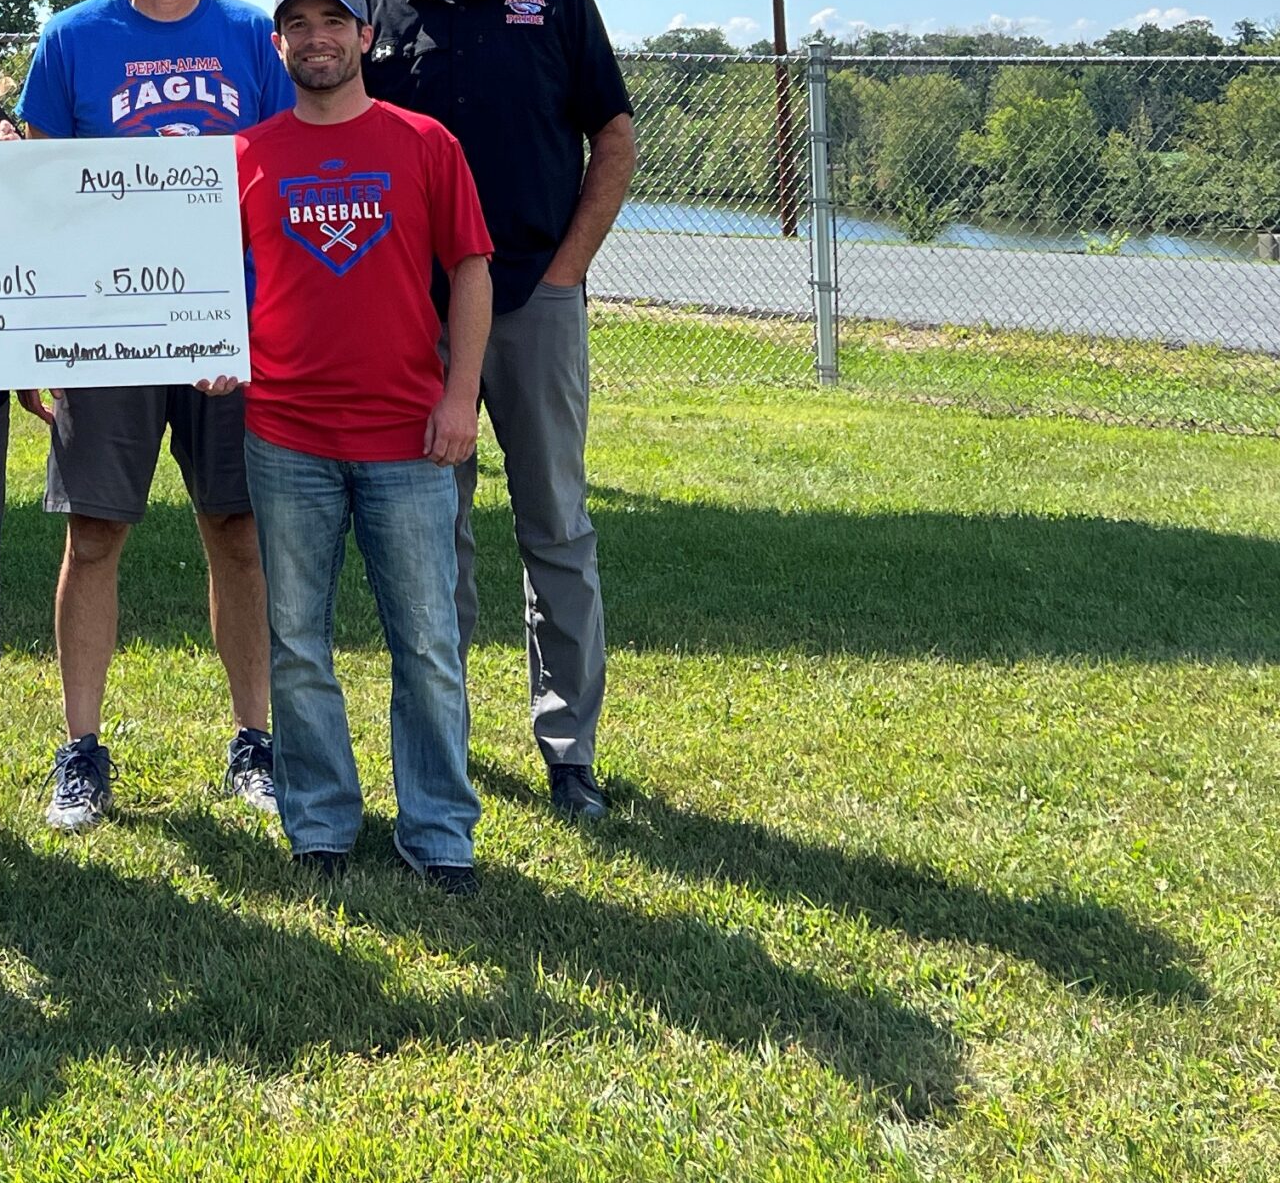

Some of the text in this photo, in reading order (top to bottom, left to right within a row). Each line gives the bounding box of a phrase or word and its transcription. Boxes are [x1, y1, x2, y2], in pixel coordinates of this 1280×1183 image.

[125, 57, 222, 76] PEPIN-ALMA
[111, 76, 240, 123] EAGLE
[187, 192, 223, 204] DATE
[287, 184, 382, 208] EAGLES
[289, 201, 384, 224] BASEBALL
[94, 280, 103, 294] $
[170, 309, 231, 322] DOLLARS
